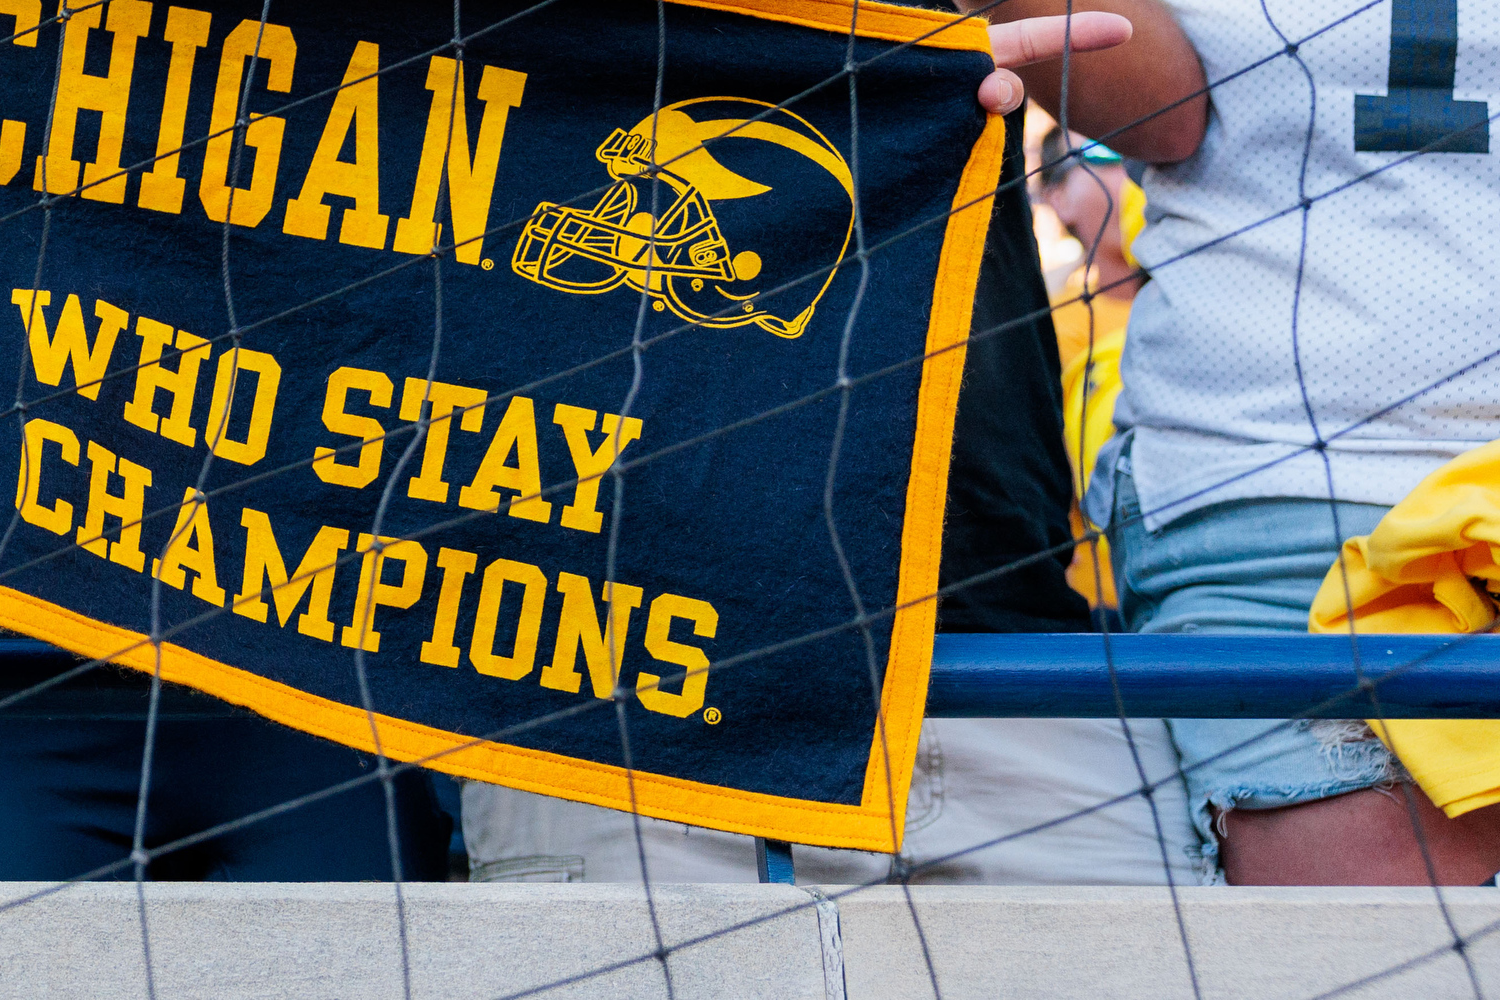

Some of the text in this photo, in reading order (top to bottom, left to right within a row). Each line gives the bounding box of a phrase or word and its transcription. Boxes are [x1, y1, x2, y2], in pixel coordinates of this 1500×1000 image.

[11, 289, 282, 465] WHO
[311, 367, 642, 533] STAY
[15, 418, 719, 719] CHAMPIONS
